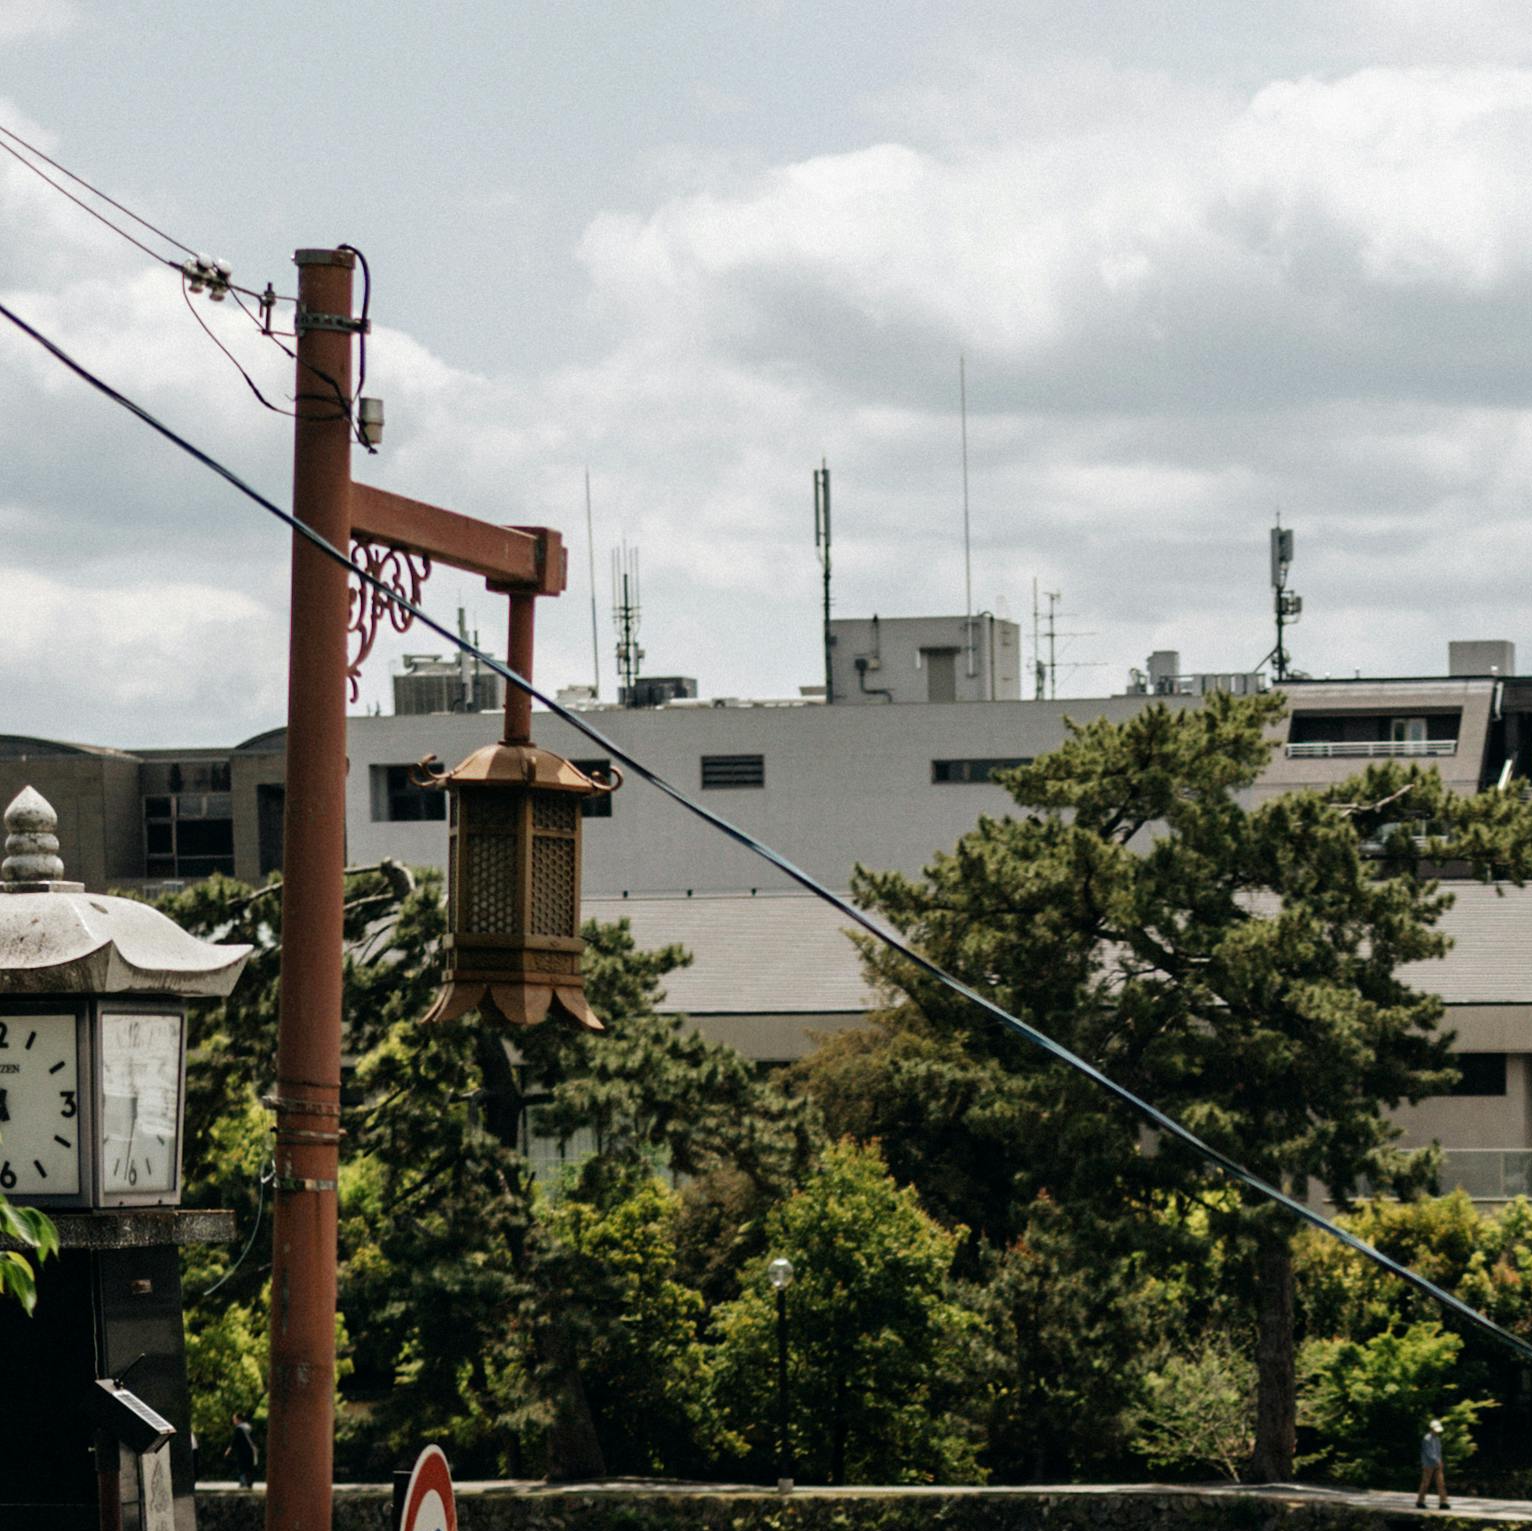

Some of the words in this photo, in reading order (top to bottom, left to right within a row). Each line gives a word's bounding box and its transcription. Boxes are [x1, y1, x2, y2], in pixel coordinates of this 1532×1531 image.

[60, 1091, 77, 1118] 3
[0, 1161, 17, 1188] 6
[128, 1160, 137, 1186] 6
